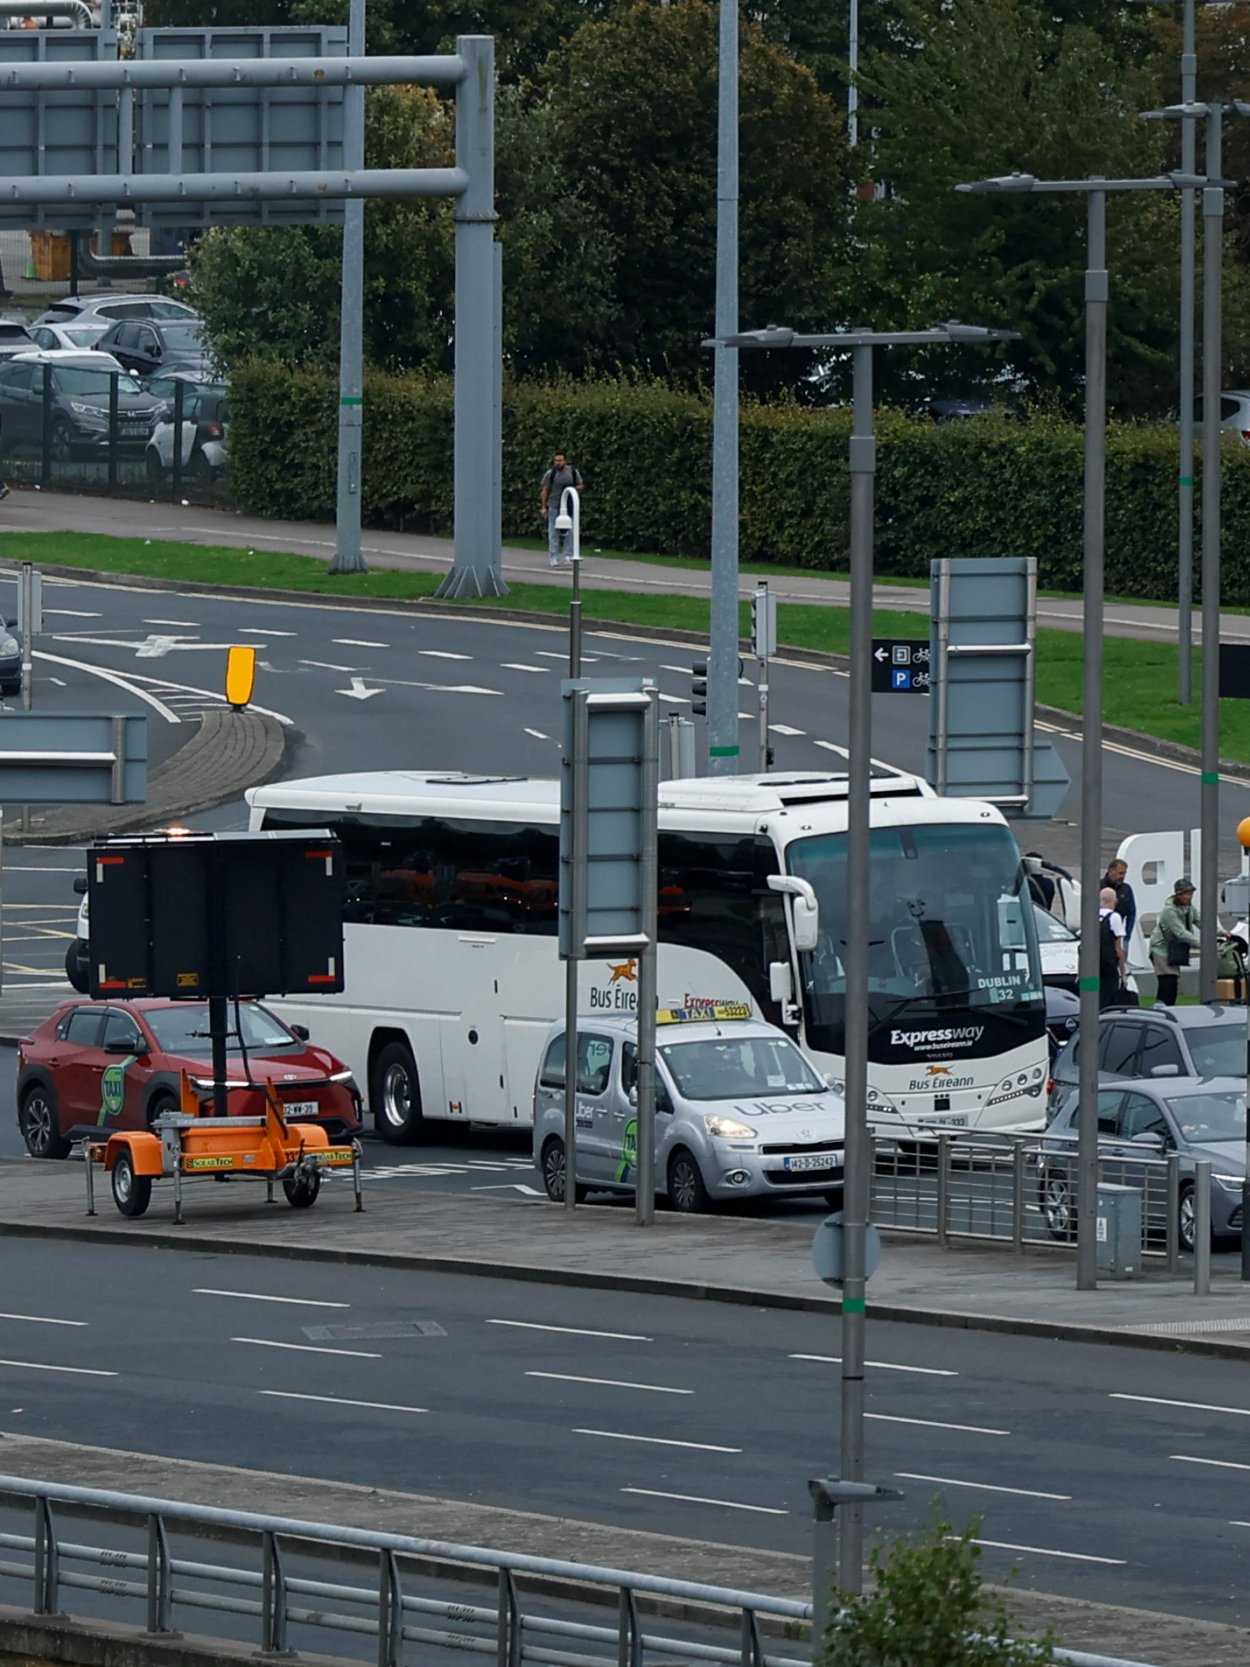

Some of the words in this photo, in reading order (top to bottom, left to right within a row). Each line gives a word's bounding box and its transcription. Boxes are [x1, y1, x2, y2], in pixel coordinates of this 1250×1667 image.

[896, 672, 906, 686] P
[978, 975, 1021, 989] DUBLIN
[590, 986, 612, 1009] Bus
[998, 989, 1014, 1000] 32
[890, 1025, 985, 1047] Expressway
[104, 1081, 121, 1098] TAXI
[909, 1079, 930, 1091] Bus
[733, 1102, 826, 1117] Uber
